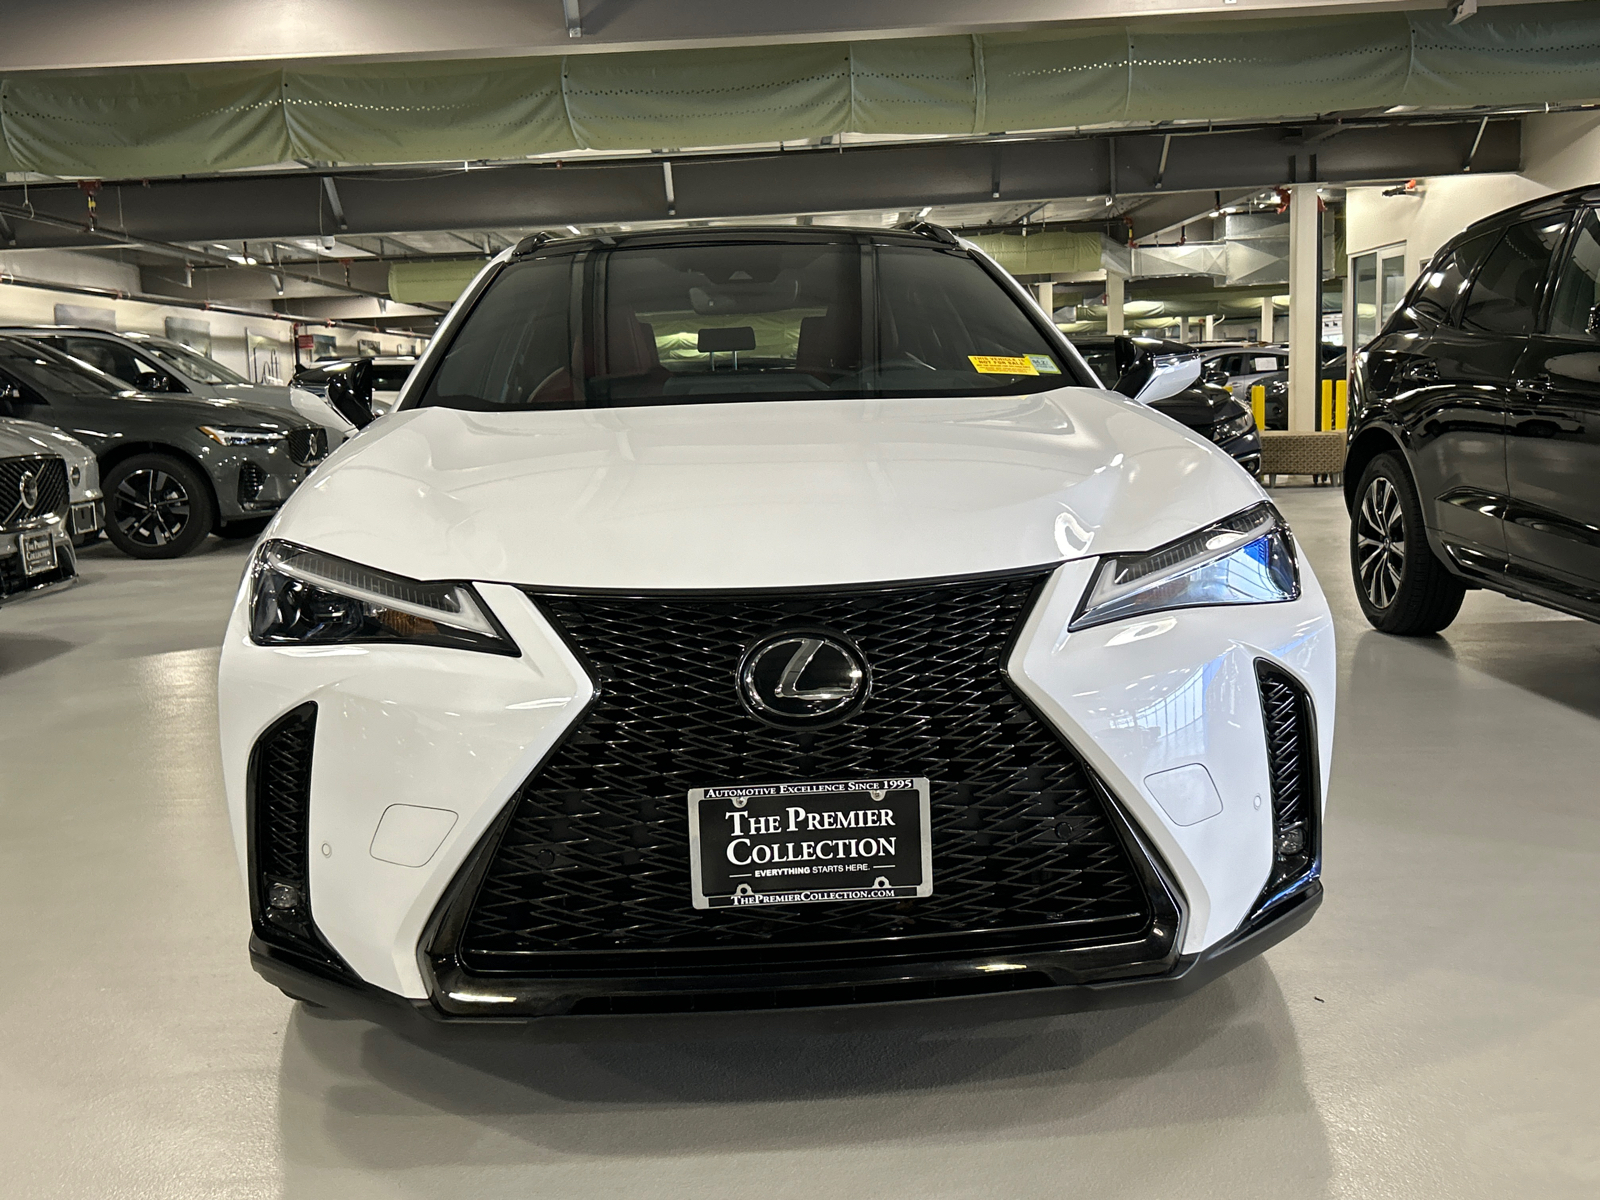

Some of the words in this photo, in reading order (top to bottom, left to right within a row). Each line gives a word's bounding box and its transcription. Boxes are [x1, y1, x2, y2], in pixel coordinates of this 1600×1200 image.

[706, 787, 776, 799] AUTOMOTIVE
[779, 784, 845, 794] EXCELLENCE
[883, 779, 912, 789] 1995
[725, 810, 782, 836] THE
[785, 807, 896, 831] PREMIER
[726, 837, 897, 865] COLLECTION
[754, 867, 810, 878] EVERYTHING
[812, 865, 844, 874] STARTS
